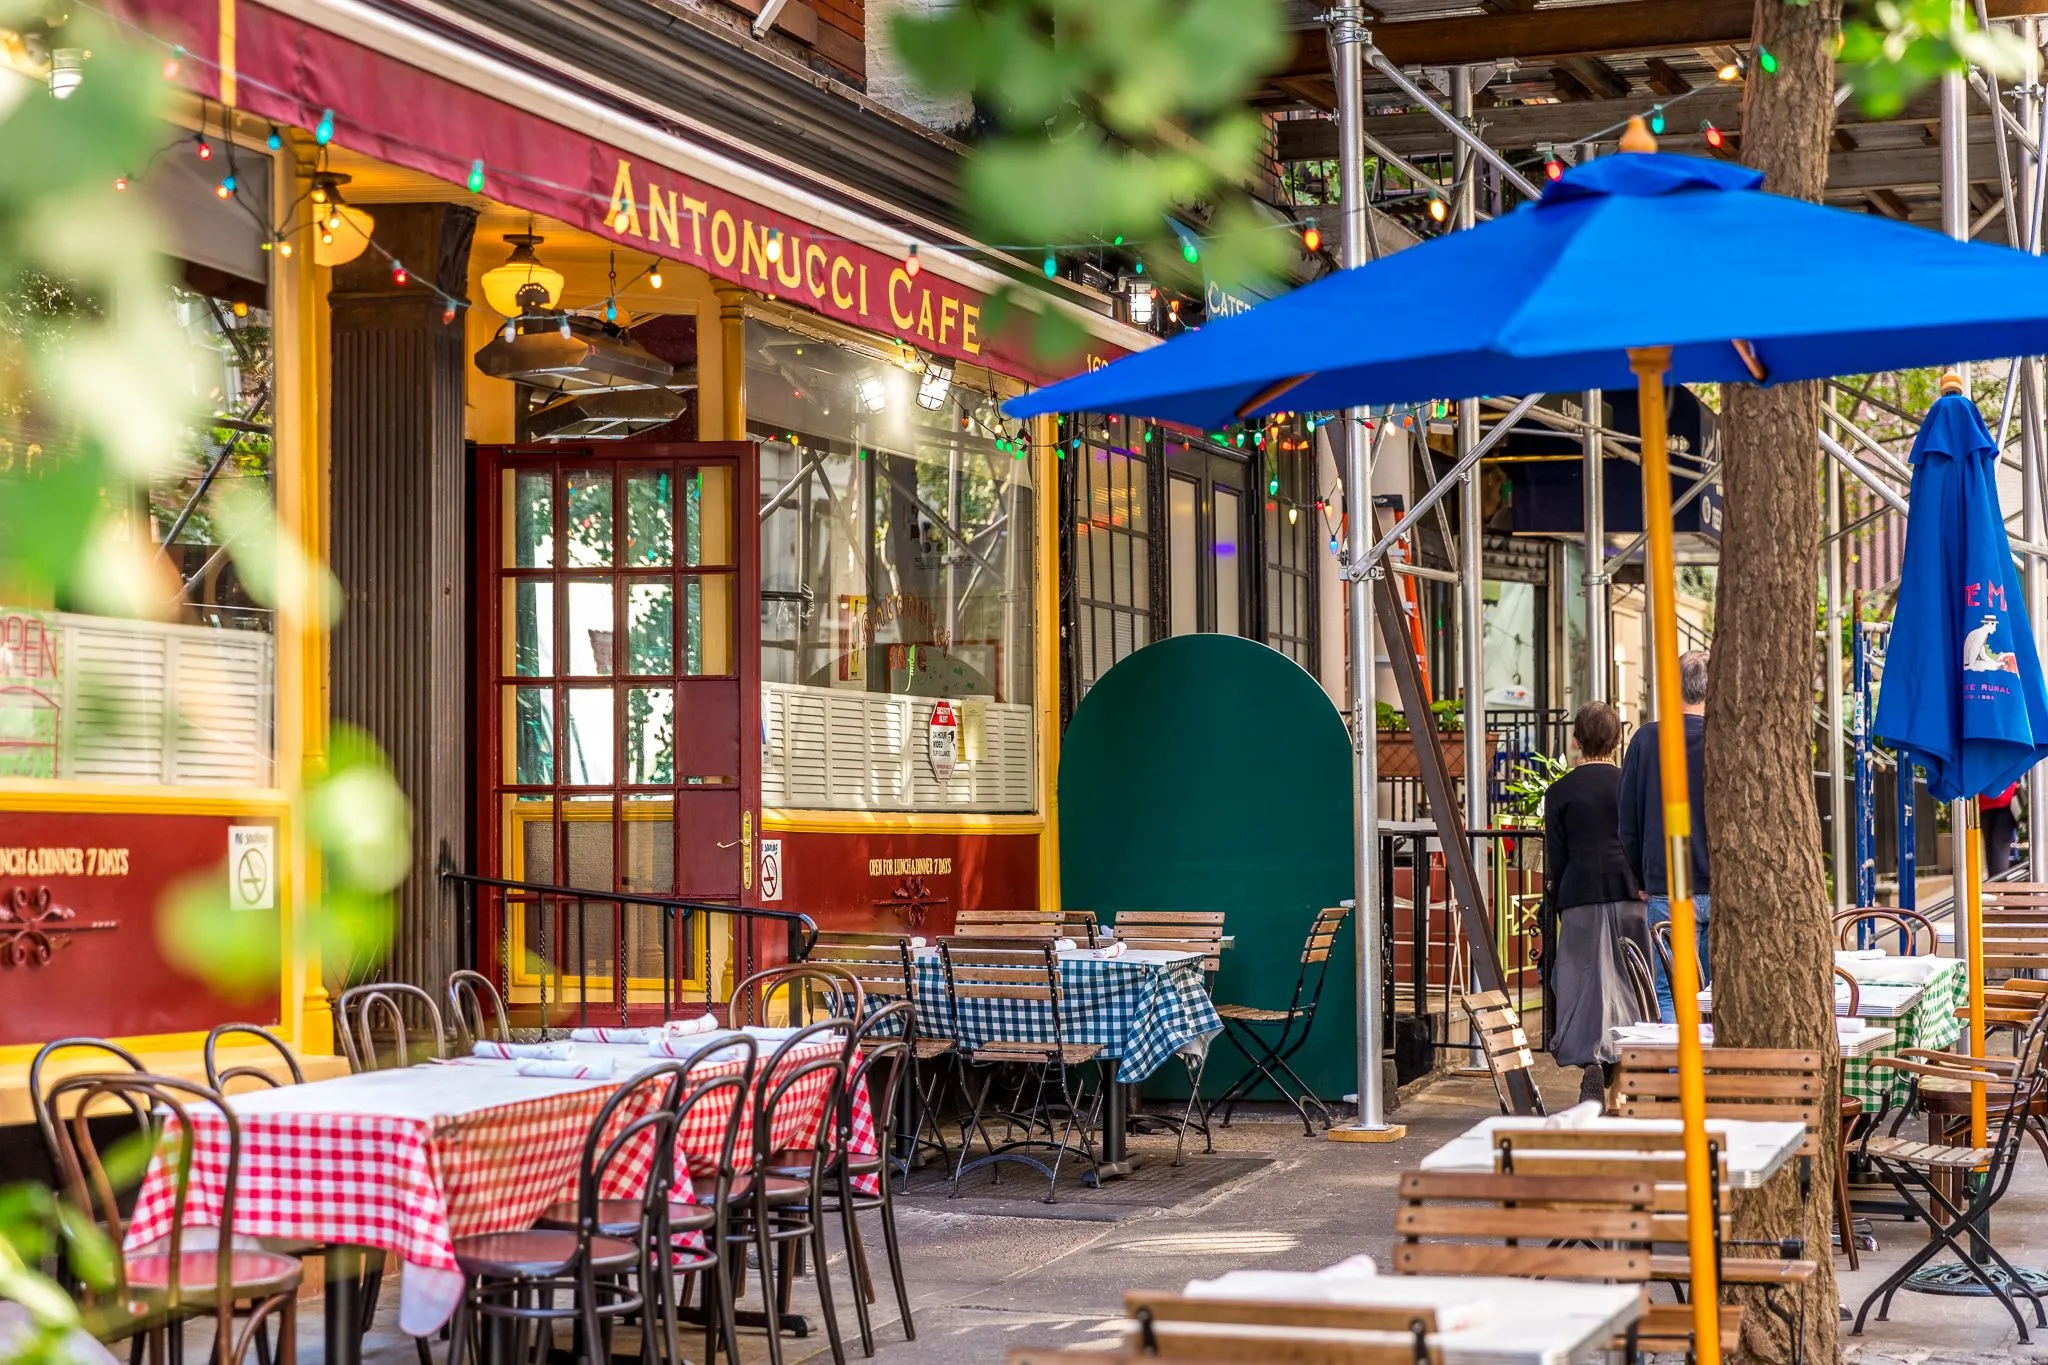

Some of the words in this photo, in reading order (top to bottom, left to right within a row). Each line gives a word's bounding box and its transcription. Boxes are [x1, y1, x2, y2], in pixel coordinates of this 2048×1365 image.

[603, 159, 868, 316] ANTONUCCI
[888, 267, 981, 356] CAFE
[1208, 280, 1256, 319] CATER
[1981, 683, 2011, 695] RURAL
[932, 740, 944, 749] VIDEO
[38, 847, 84, 876] DINNER
[86, 848, 97, 876] 7
[97, 847, 130, 876] DAYS
[869, 858, 882, 877] OPEN
[883, 858, 894, 876] FOR
[894, 858, 912, 876] LUNCH
[915, 857, 934, 875] DINNER
[938, 857, 952, 875] DAYS
